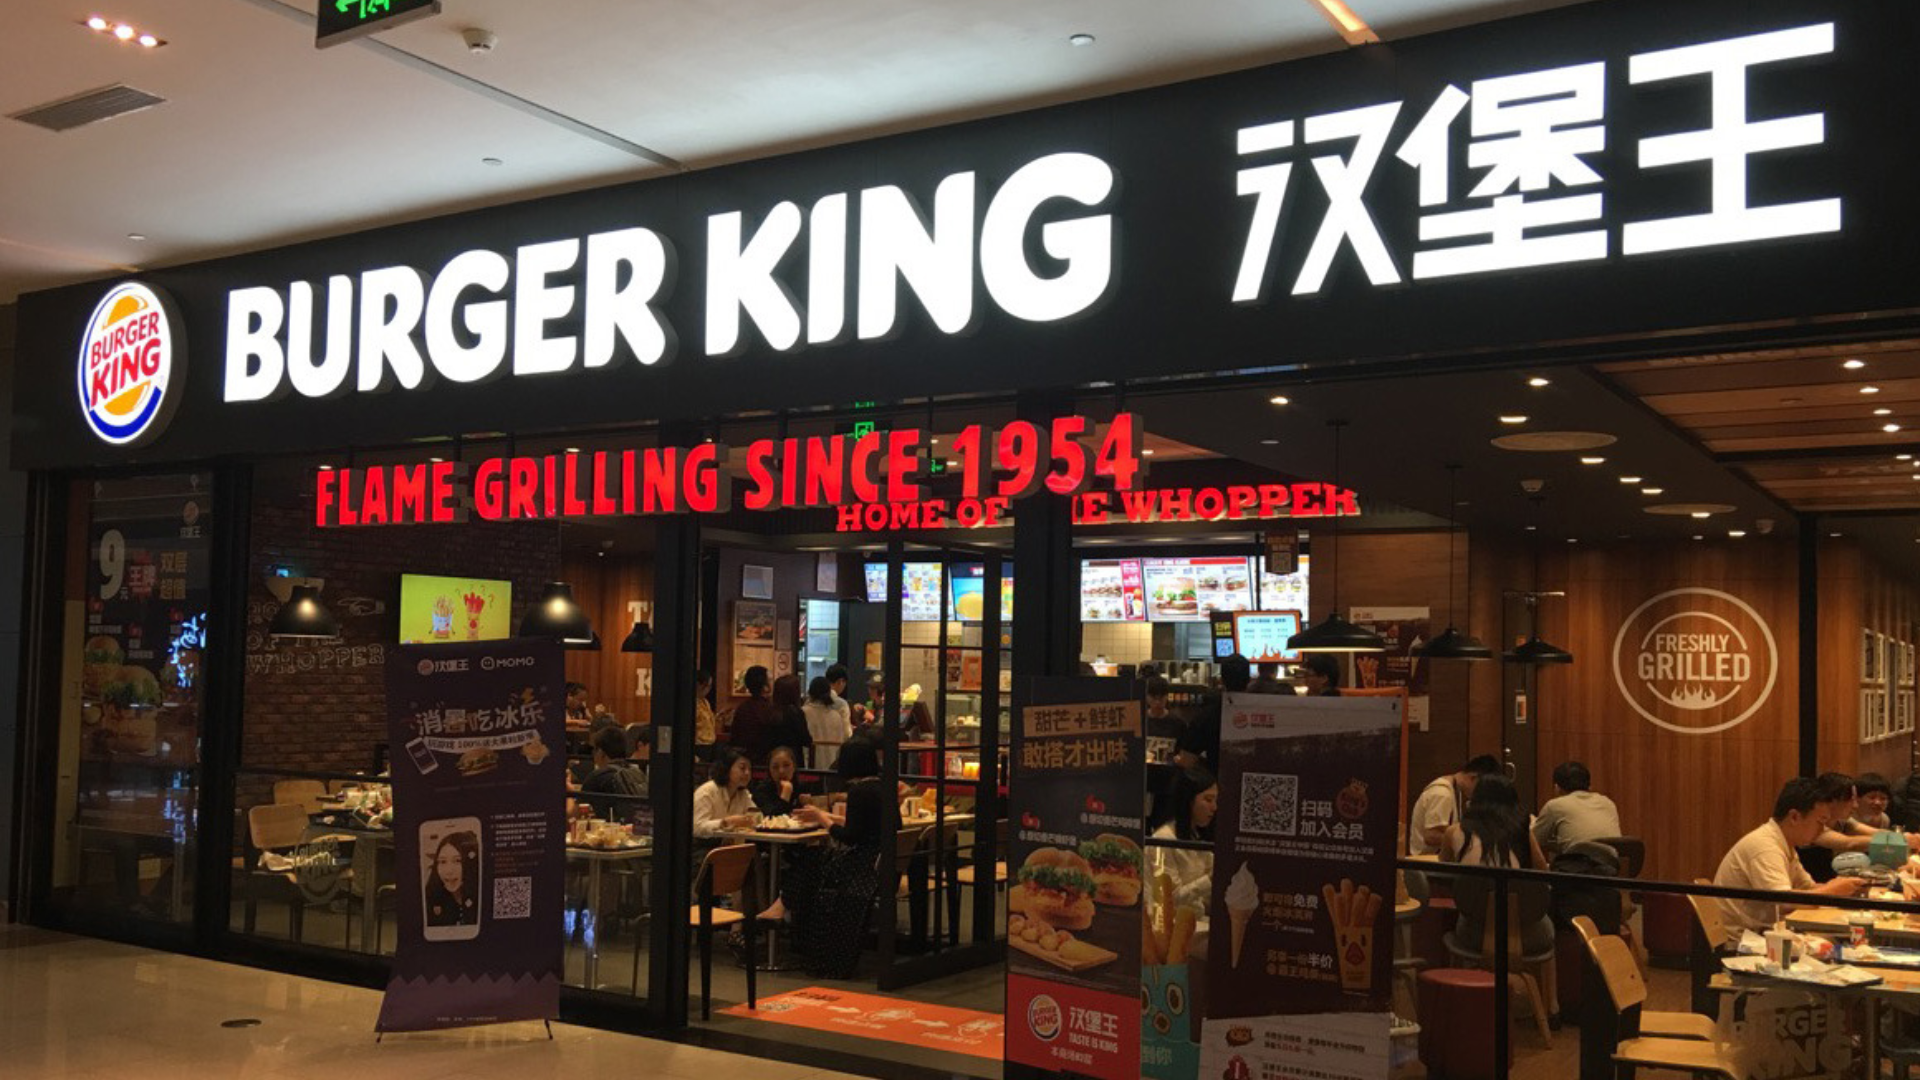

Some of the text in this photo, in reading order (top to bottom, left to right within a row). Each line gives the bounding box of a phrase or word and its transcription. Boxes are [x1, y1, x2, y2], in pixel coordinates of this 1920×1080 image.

[1232, 22, 1842, 302] 汉堡王
[223, 152, 1114, 402] BURGER KING
[91, 312, 159, 369] BURGER
[91, 338, 161, 408] KING
[316, 413, 1139, 527] FLAME GRILLING SINCE 1954
[836, 500, 945, 532] HOME
[956, 497, 1009, 528] OF
[246, 643, 385, 674] WHOPPER
[1655, 633, 1730, 653] FRESHLY
[496, 656, 536, 668] MOMO
[1637, 651, 1751, 682] GRILLED
[415, 701, 546, 736] 消暑吃冰乐
[1022, 737, 1129, 770] 敢搭才出味
[1300, 800, 1334, 818] 扫码
[1299, 820, 1365, 841] 加入会员
[1069, 1005, 1119, 1039] 汉堡王
[1068, 1032, 1091, 1048] TASTE
